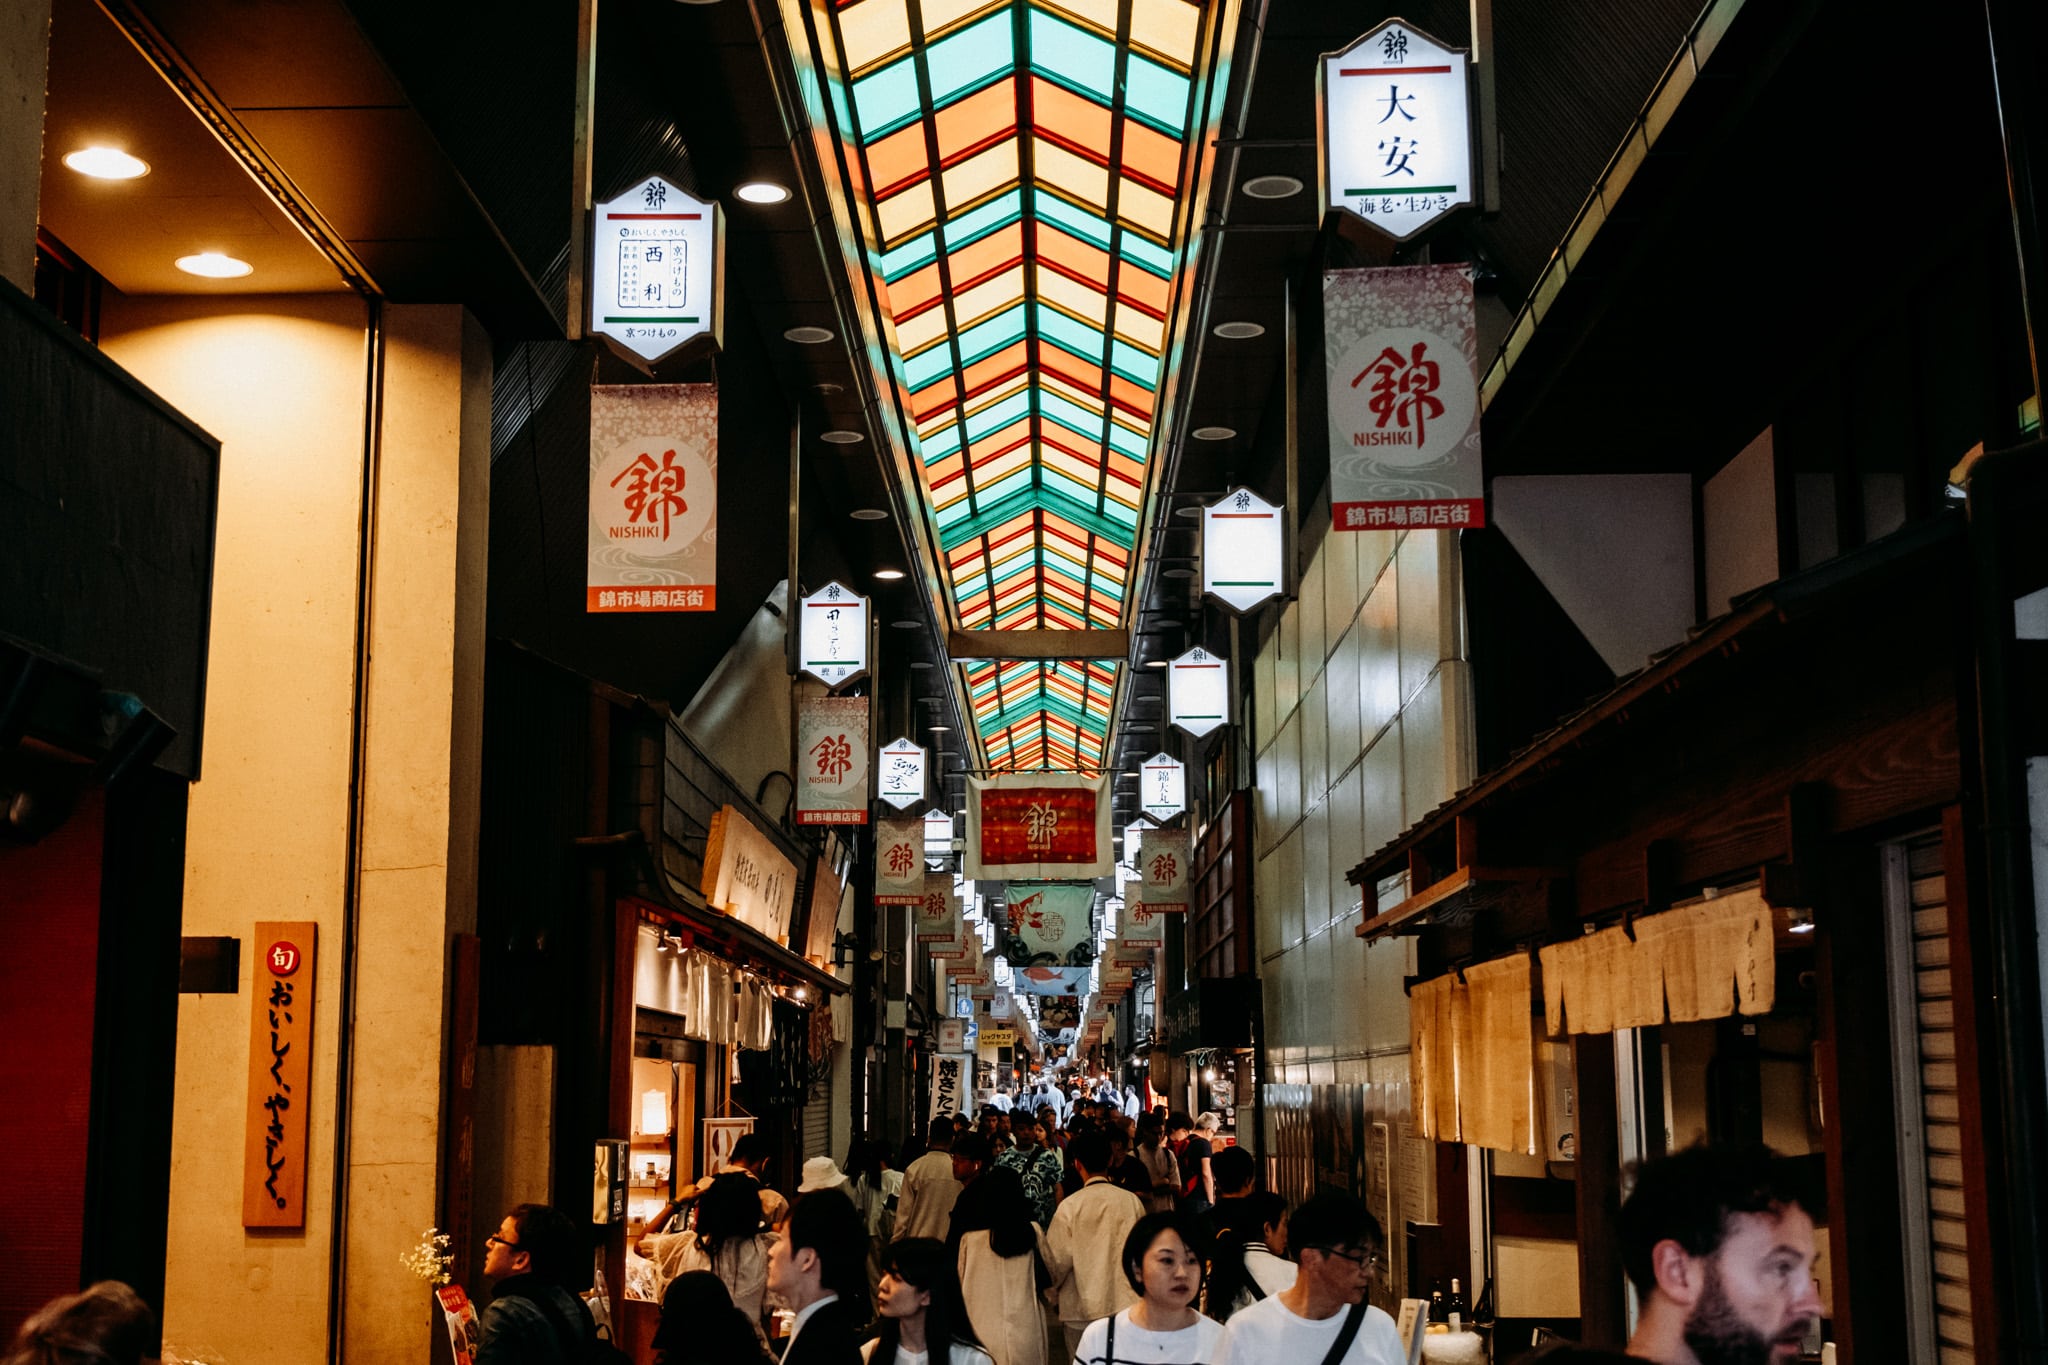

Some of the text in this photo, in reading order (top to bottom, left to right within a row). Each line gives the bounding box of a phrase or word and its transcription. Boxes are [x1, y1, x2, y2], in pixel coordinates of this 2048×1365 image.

[1378, 29, 1408, 65] 錦
[1376, 85, 1418, 178] 大安
[641, 181, 666, 210] 錦
[1358, 195, 1449, 215] 海老・生かき
[643, 246, 664, 301] 西利
[672, 246, 683, 297] 京つけもの
[625, 327, 677, 338] 京つけもの
[1350, 341, 1446, 450] 錦
[1353, 431, 1413, 448] NISHIKI
[610, 448, 689, 543] 錦
[609, 526, 659, 539] NISHIKI
[1345, 504, 1471, 527] 錦市場商店街
[598, 589, 705, 608] 錦市場商店街
[809, 733, 853, 786] 錦
[808, 776, 837, 784] NISHIKI
[803, 811, 861, 823] 錦市場商店街
[1020, 800, 1058, 850] 錦
[884, 842, 914, 879] 錦
[1148, 852, 1178, 886] 錦
[271, 947, 294, 970] 旬
[263, 980, 294, 1210] おいしく、やさしく。
